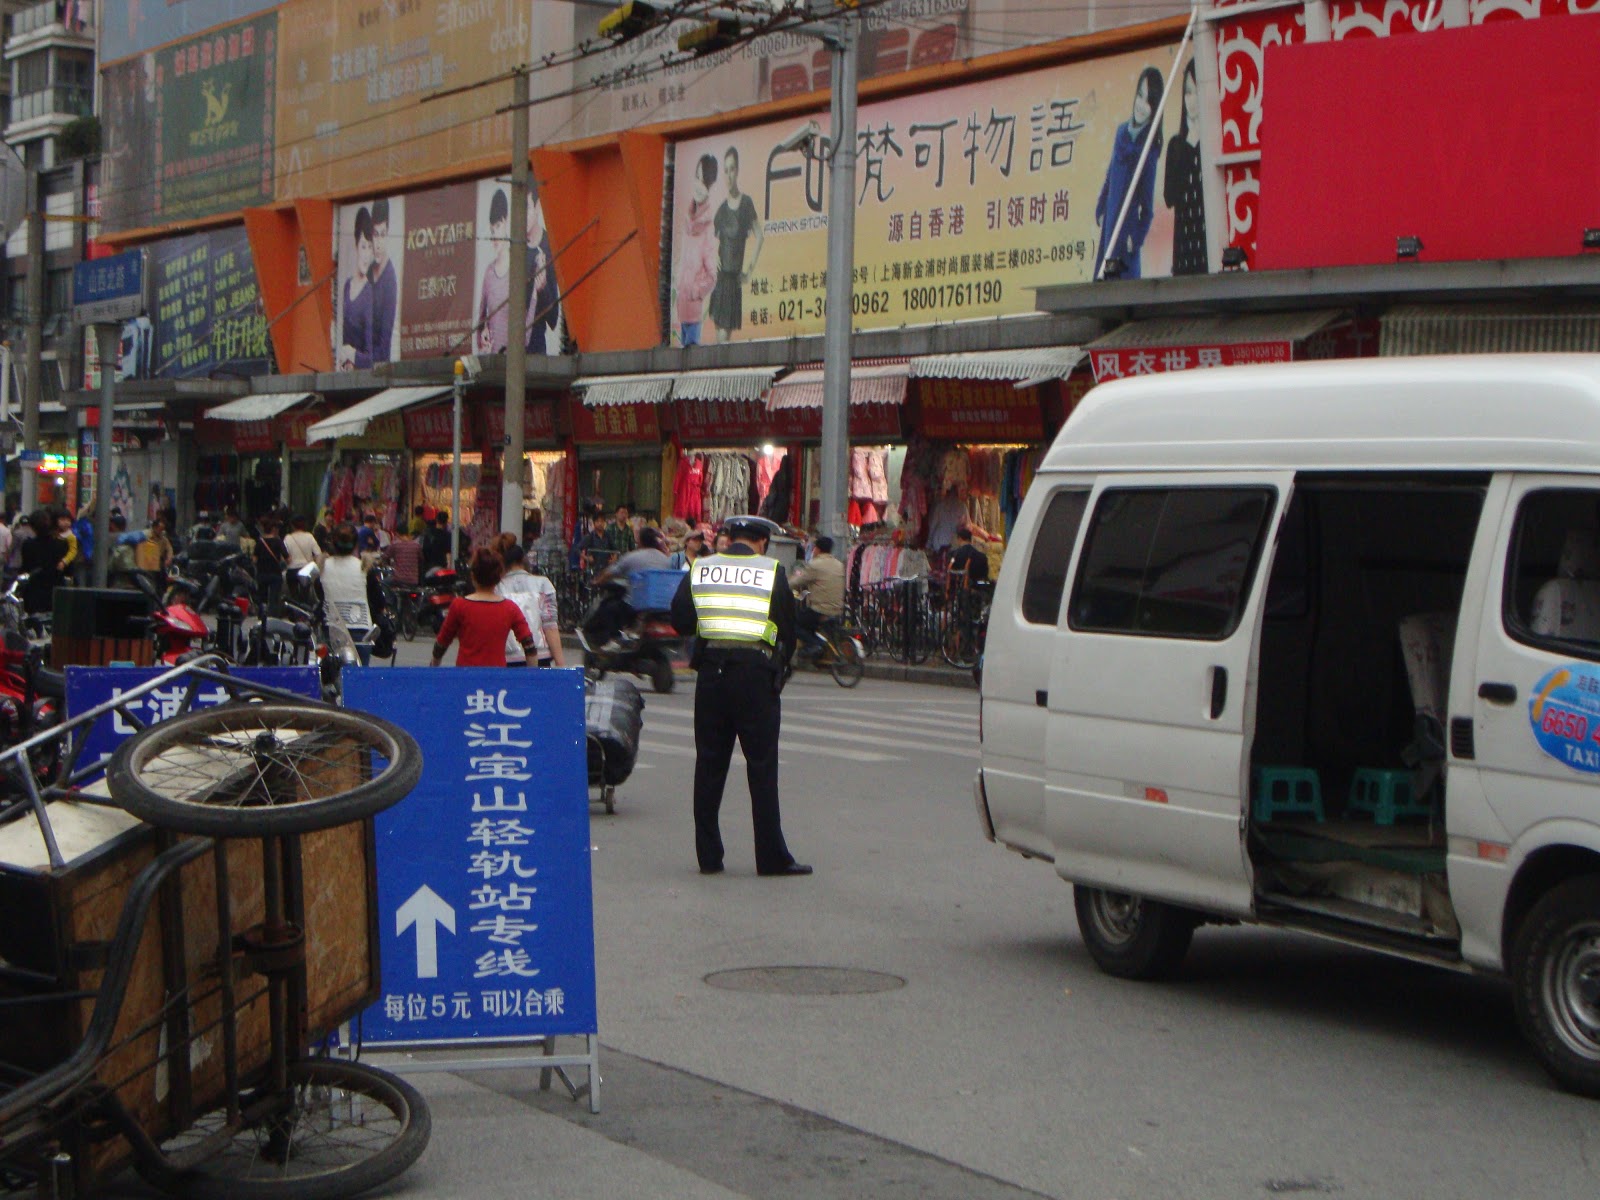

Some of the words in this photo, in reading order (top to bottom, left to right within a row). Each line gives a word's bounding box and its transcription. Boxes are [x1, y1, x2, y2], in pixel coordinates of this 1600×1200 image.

[800, 215, 828, 231] STOR
[888, 204, 964, 243] 源自香港
[986, 190, 1070, 230] 引领时尚
[902, 279, 1002, 311] 18001761190
[700, 566, 765, 587] POLICE
[1542, 708, 1588, 742] 6650
[1565, 743, 1599, 768] TAXI
[384, 991, 471, 1022] 每位5元
[480, 987, 565, 1017] 可以合乘
